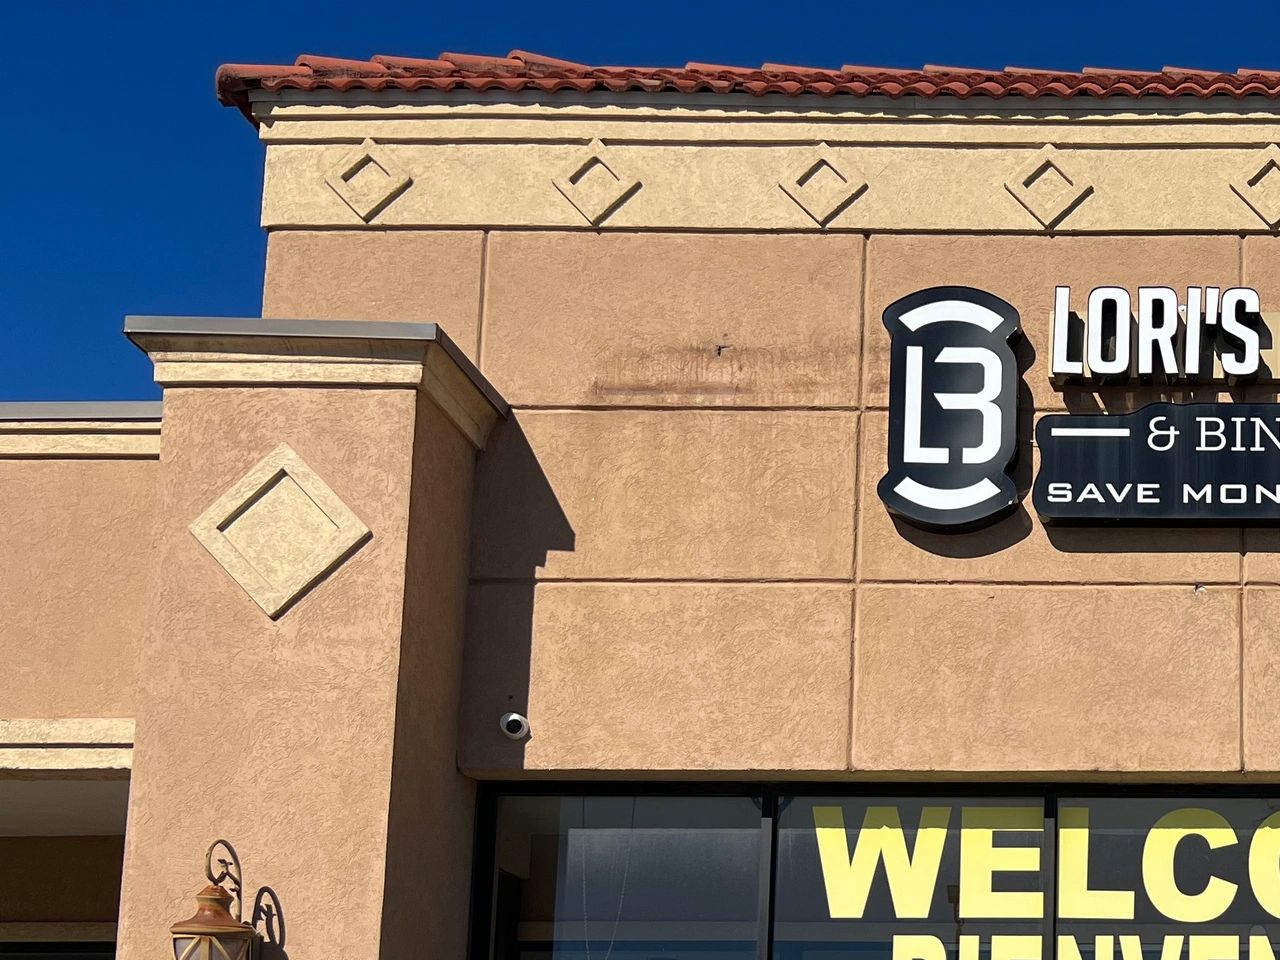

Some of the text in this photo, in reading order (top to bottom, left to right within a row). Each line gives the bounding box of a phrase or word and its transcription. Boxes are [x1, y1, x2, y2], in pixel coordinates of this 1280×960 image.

[1053, 286, 1262, 376] LORI'S
[1147, 417, 1180, 452] &
[1047, 482, 1161, 504] SAVE
